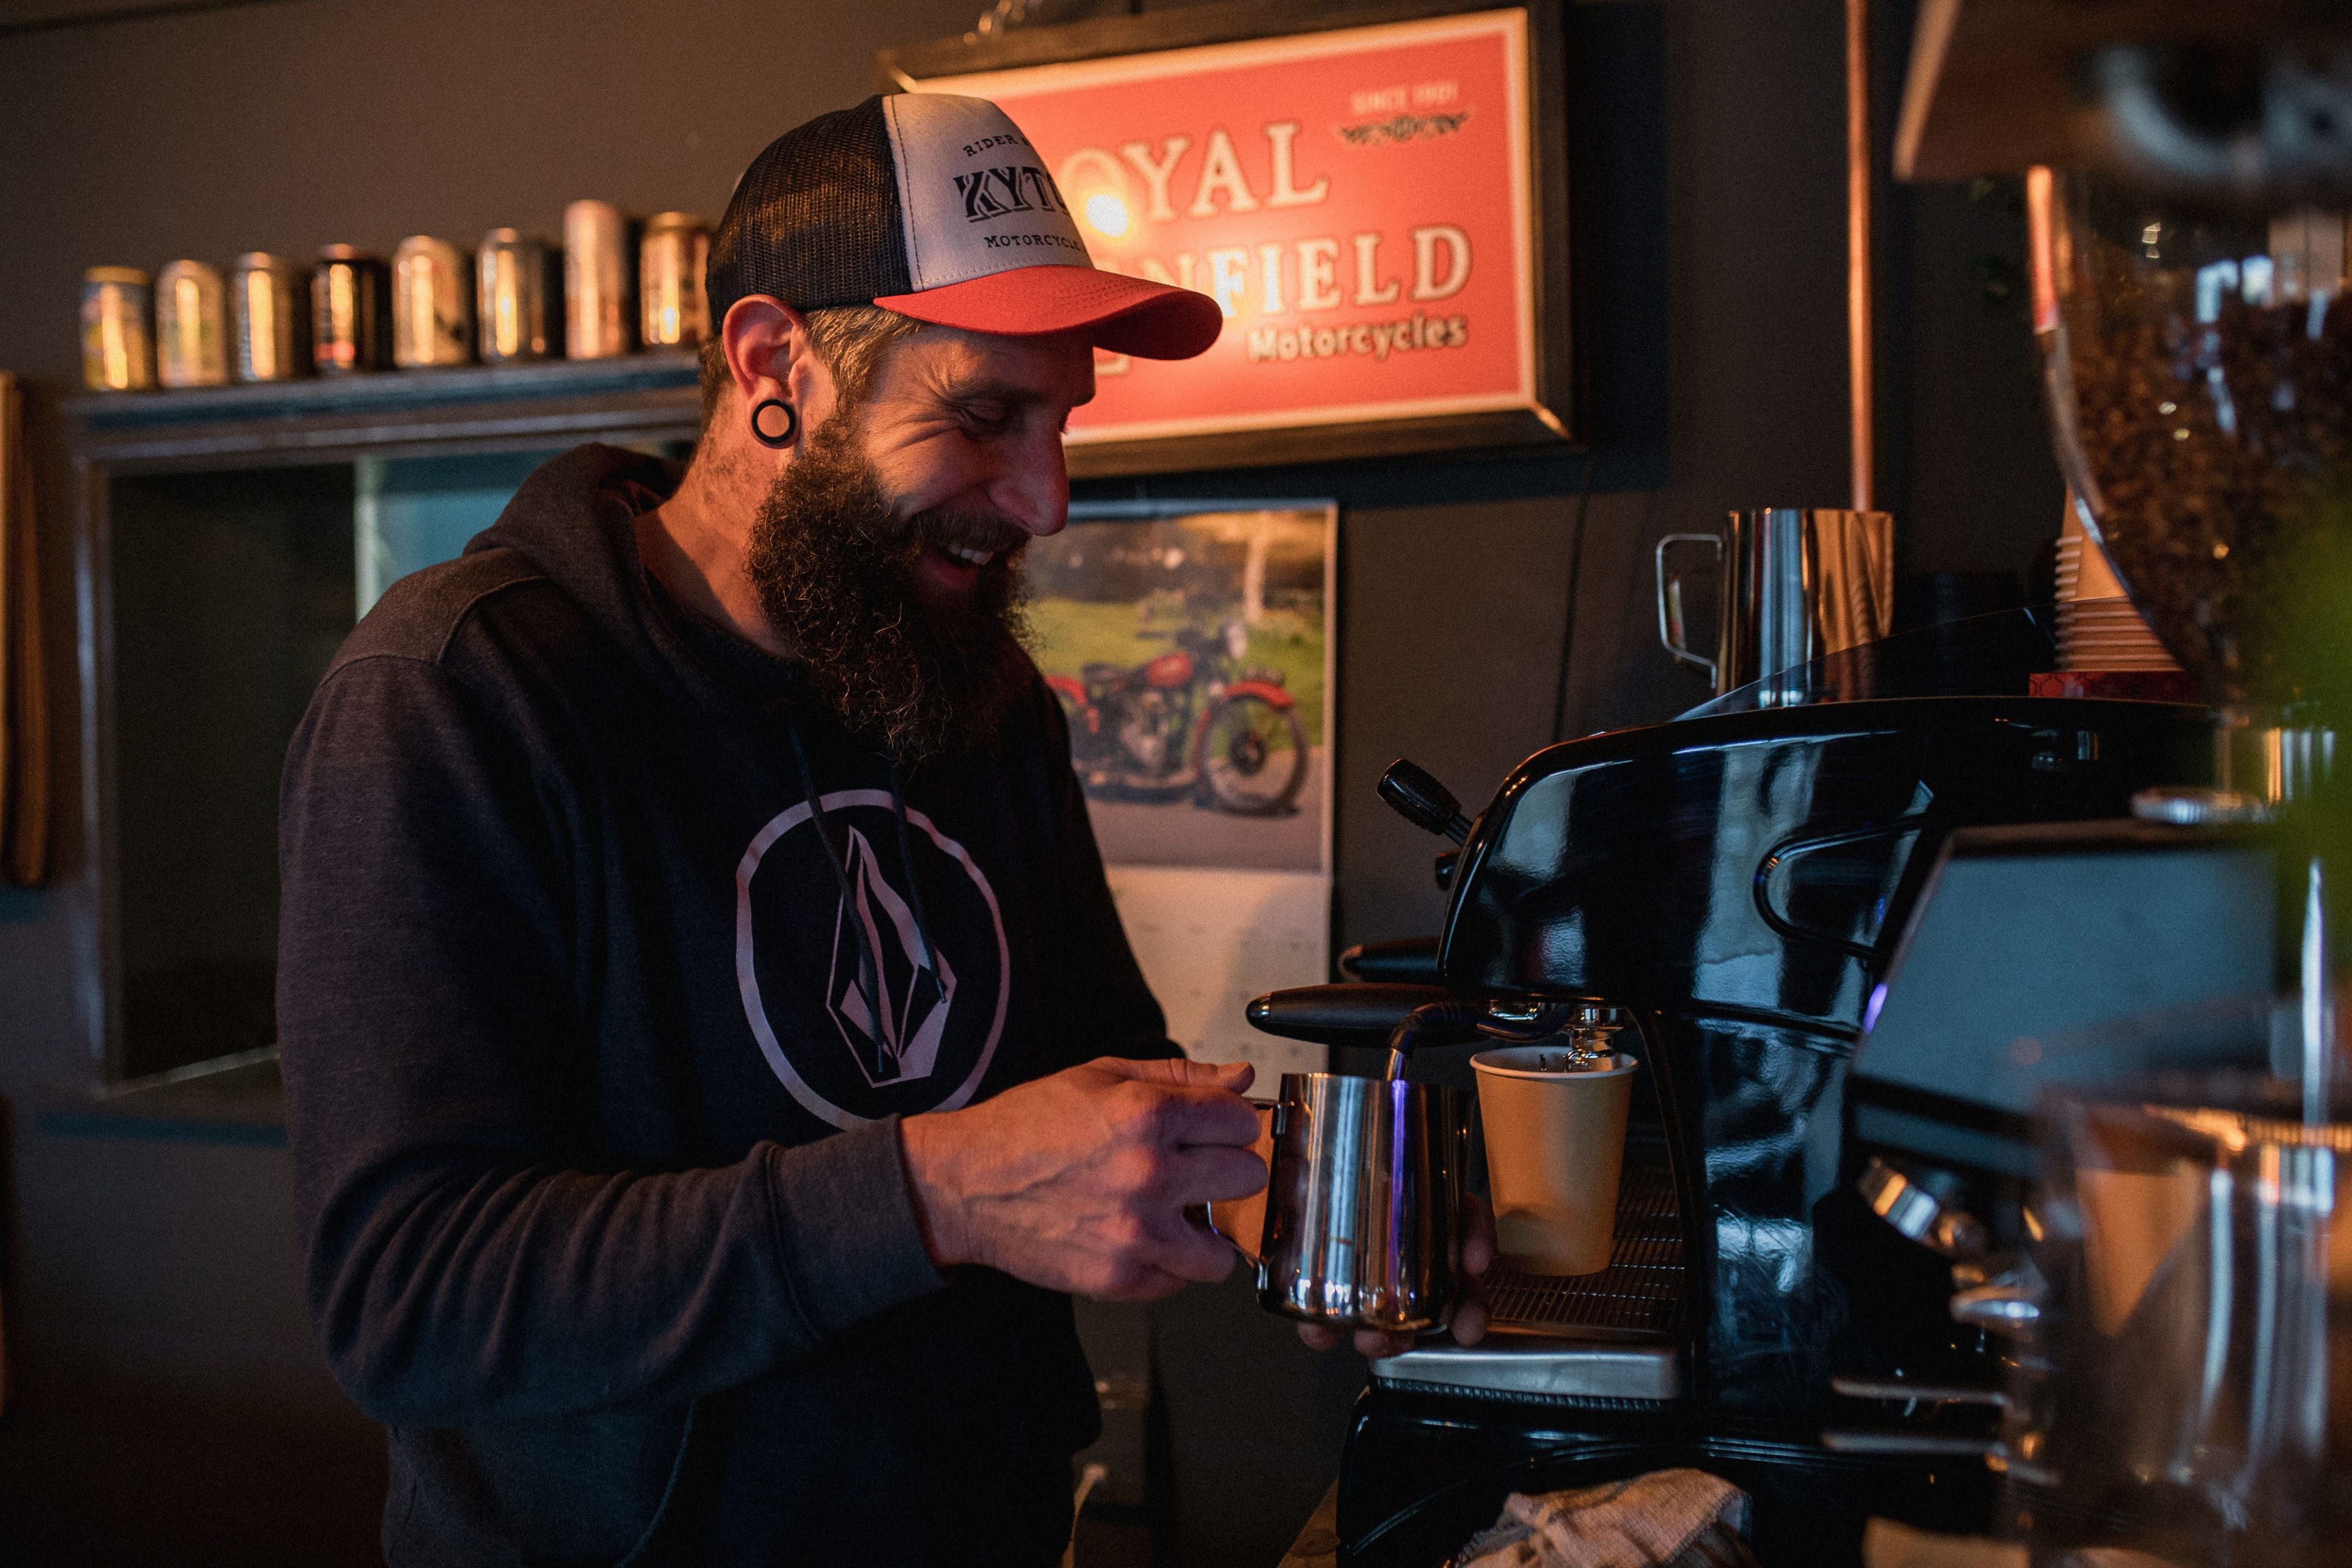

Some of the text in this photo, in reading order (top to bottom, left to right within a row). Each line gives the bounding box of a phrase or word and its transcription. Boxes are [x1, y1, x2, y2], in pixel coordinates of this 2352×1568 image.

[963, 134, 1018, 157] RIDER
[1058, 121, 1331, 222] OYAL
[984, 235, 1086, 252] MOTORCYCLE
[1095, 222, 1473, 318] FIELD
[1247, 310, 1467, 363] Motorcycles
